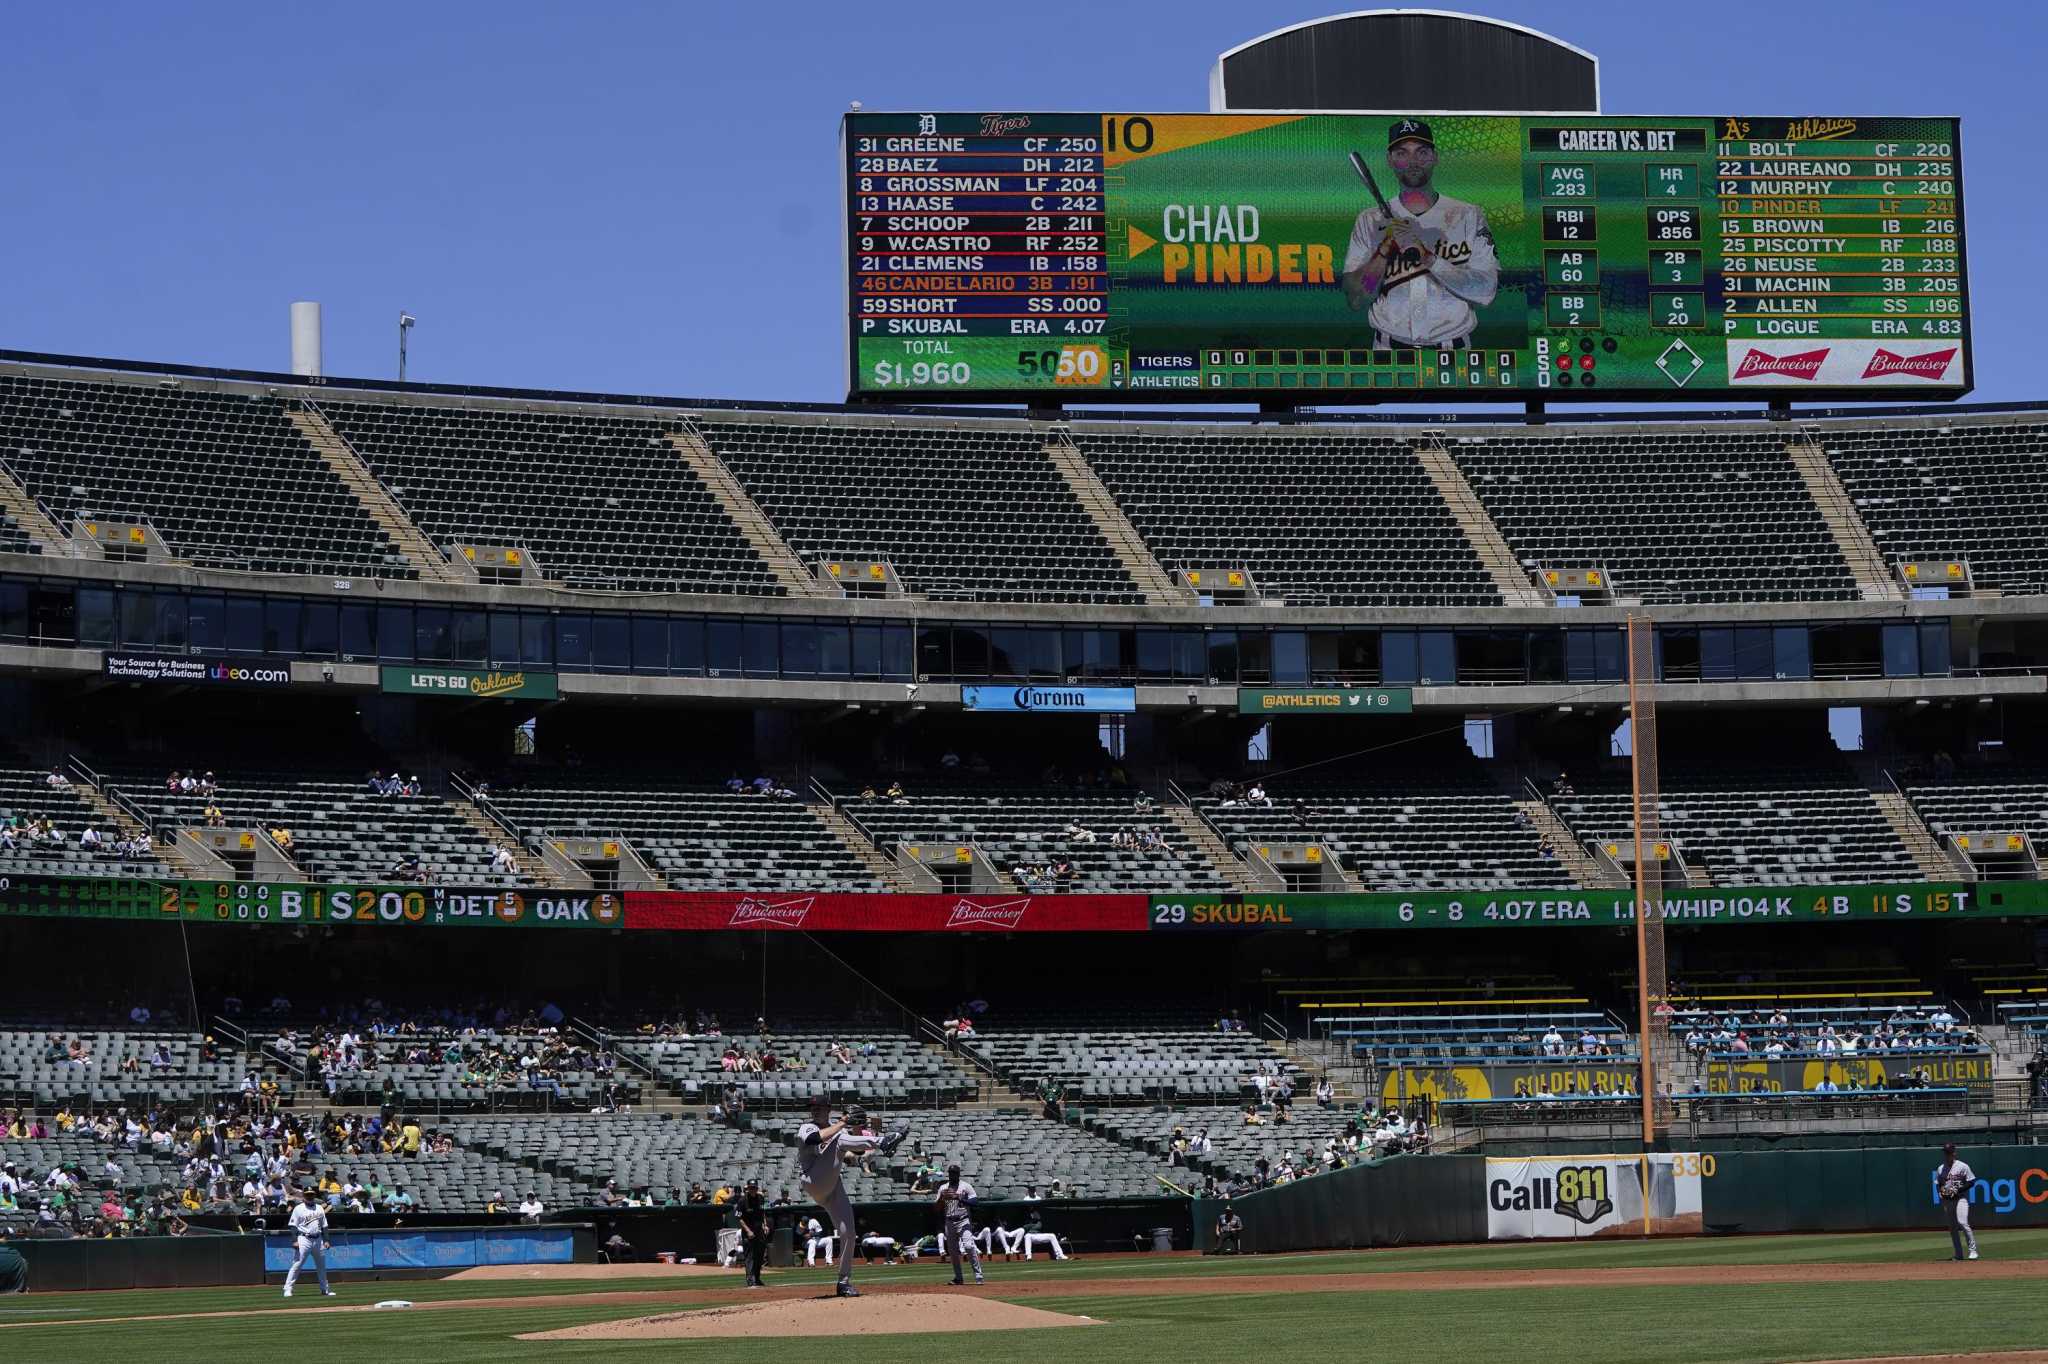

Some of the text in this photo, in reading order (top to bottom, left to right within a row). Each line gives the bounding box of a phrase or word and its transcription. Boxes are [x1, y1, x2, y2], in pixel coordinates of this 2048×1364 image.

[980, 115, 1030, 136] Tigers
[1724, 119, 1749, 140] A's
[1786, 119, 1856, 141] Athletics
[1108, 117, 1154, 152] 10
[1559, 130, 1675, 151] CAREER VS. DET
[859, 138, 1097, 152] 31 GREENE CF .250
[1719, 143, 1951, 156] 11 BOLT CF .220
[859, 158, 1094, 172] 28 BAEZ DH .212
[1719, 162, 1951, 176] 22 LAUREANO DH .235
[1552, 168, 1584, 180] AVG
[1660, 168, 1683, 180] HR
[861, 178, 1097, 192] 8 GROSSMAN LF .204
[1551, 184, 1586, 196] .283
[1665, 184, 1676, 196] 4
[1720, 181, 1952, 195] 12 MURPHY C .240
[861, 197, 1097, 211] 13 HAASE C .242
[1721, 200, 1954, 214] 10 PINDER LF .241
[861, 217, 1092, 231] 7 SCHOOP 2B .211
[1163, 205, 1259, 242] CHAD
[1557, 211, 1583, 223] RBI
[1657, 211, 1690, 223] OPS
[1563, 227, 1578, 239] 12
[1657, 227, 1693, 239] .856
[1722, 220, 1955, 233] 15 BROWN 1B .216
[861, 237, 1098, 251] 9 W.CASTRO RF .252
[1723, 239, 1955, 253] 25 PISCOTTY RF .188
[861, 257, 1098, 271] 21 CLEMENS 1B .158
[1163, 244, 1334, 283] PINDER
[1561, 253, 1582, 265] AB
[1664, 253, 1685, 264] 2B
[1724, 258, 1956, 272] 26 NEUSE 2B .233
[863, 276, 1095, 290] 46 CANDELARIO 3B .191
[1561, 270, 1583, 282] 60
[1671, 270, 1681, 282] 3
[1725, 278, 1957, 292] 31 MACHIN 3B .205
[863, 298, 1101, 313] 59 SHORT SS .000
[1562, 297, 1584, 309] BB
[1672, 297, 1684, 309] G
[1725, 299, 1959, 313] 2 ALLEN SS .196
[1569, 313, 1579, 325] 2
[1667, 313, 1688, 325] 20
[863, 319, 1105, 334] P SKUBAL ERA 4.07
[1725, 319, 1961, 334] P LOGUE ERA 4.83
[903, 341, 953, 354] TOTAL
[1138, 356, 1193, 366] TIGERS
[1743, 355, 1822, 371] Budweiser
[1871, 355, 1950, 371] Budweiser
[874, 360, 970, 387] $1,960
[1130, 376, 1199, 387] ATHLETICS
[108, 658, 205, 670] Your Source for Business
[108, 666, 206, 678] Technology Solutions!
[210, 663, 288, 682] ubeo.com
[411, 672, 525, 693] LET'S GO Oakland
[1013, 686, 1085, 710] Corona
[1262, 695, 1341, 708] @ATHLETICS
[450, 895, 497, 916] DET
[536, 899, 590, 920] OAK
[1483, 901, 1591, 920] 4.07 ERA
[1659, 899, 1725, 918] WHIP
[1729, 897, 1793, 917] 104 K
[1813, 896, 1850, 914] 4 B
[1873, 894, 1912, 913] 11 S
[736, 900, 805, 922] Budweiser
[952, 901, 1022, 922] Budweiser
[1155, 904, 1292, 924] 29 SKUBAL
[1399, 902, 1463, 922] 6 8
[1514, 1071, 1589, 1095] GOLDEN
[1671, 1154, 1717, 1177] 330
[1490, 1167, 1608, 1211] Call 811
